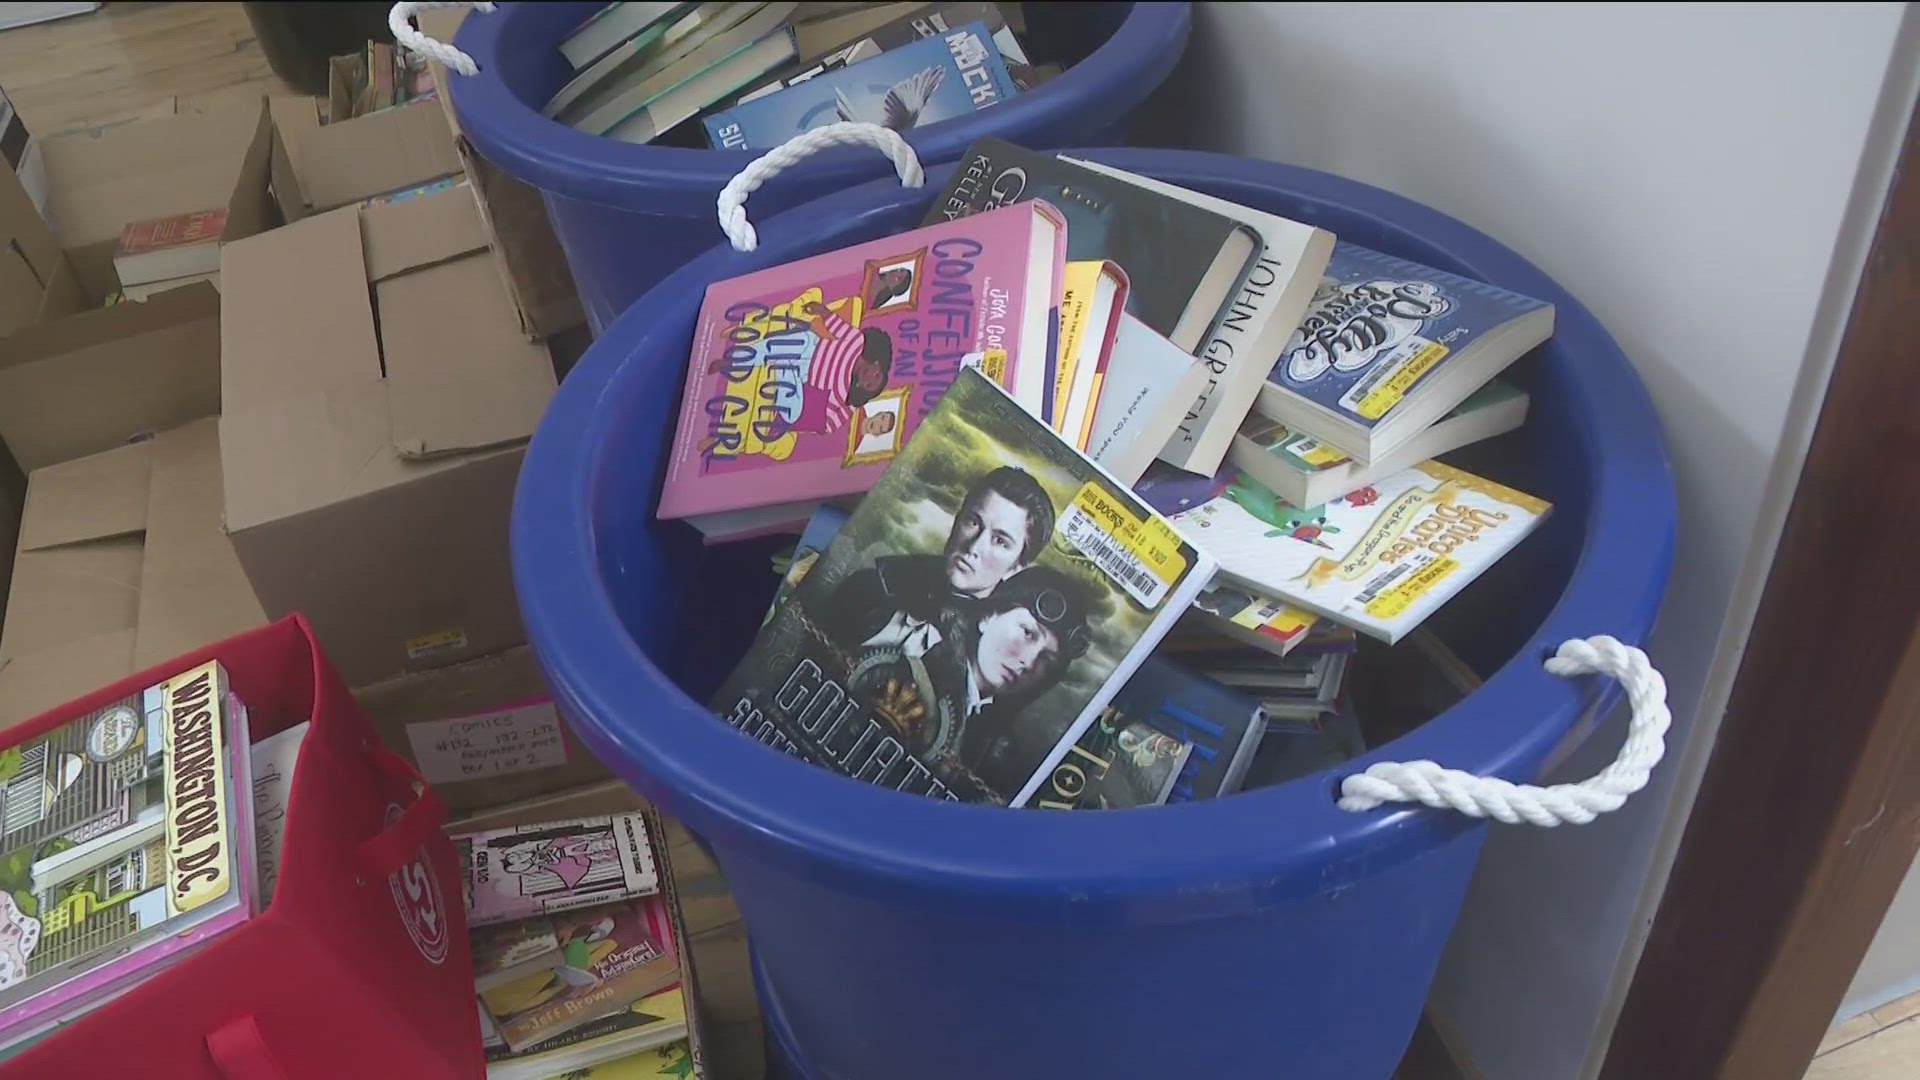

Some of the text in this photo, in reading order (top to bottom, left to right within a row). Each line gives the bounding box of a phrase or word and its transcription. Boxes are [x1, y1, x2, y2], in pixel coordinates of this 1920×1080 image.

[1223, 245, 1282, 334] JOHN
[1300, 281, 1433, 367] Dolly
[893, 318, 920, 378] OF AN
[920, 237, 983, 420] CONFESSIO
[985, 323, 1007, 352] GOF
[699, 301, 770, 474] GOOD GIRL
[757, 311, 808, 443] ALLEGED
[1428, 505, 1511, 555] Unico
[176, 841, 220, 899] D.C.
[529, 1009, 562, 1029] Jeff
[564, 986, 616, 1016] Brown
